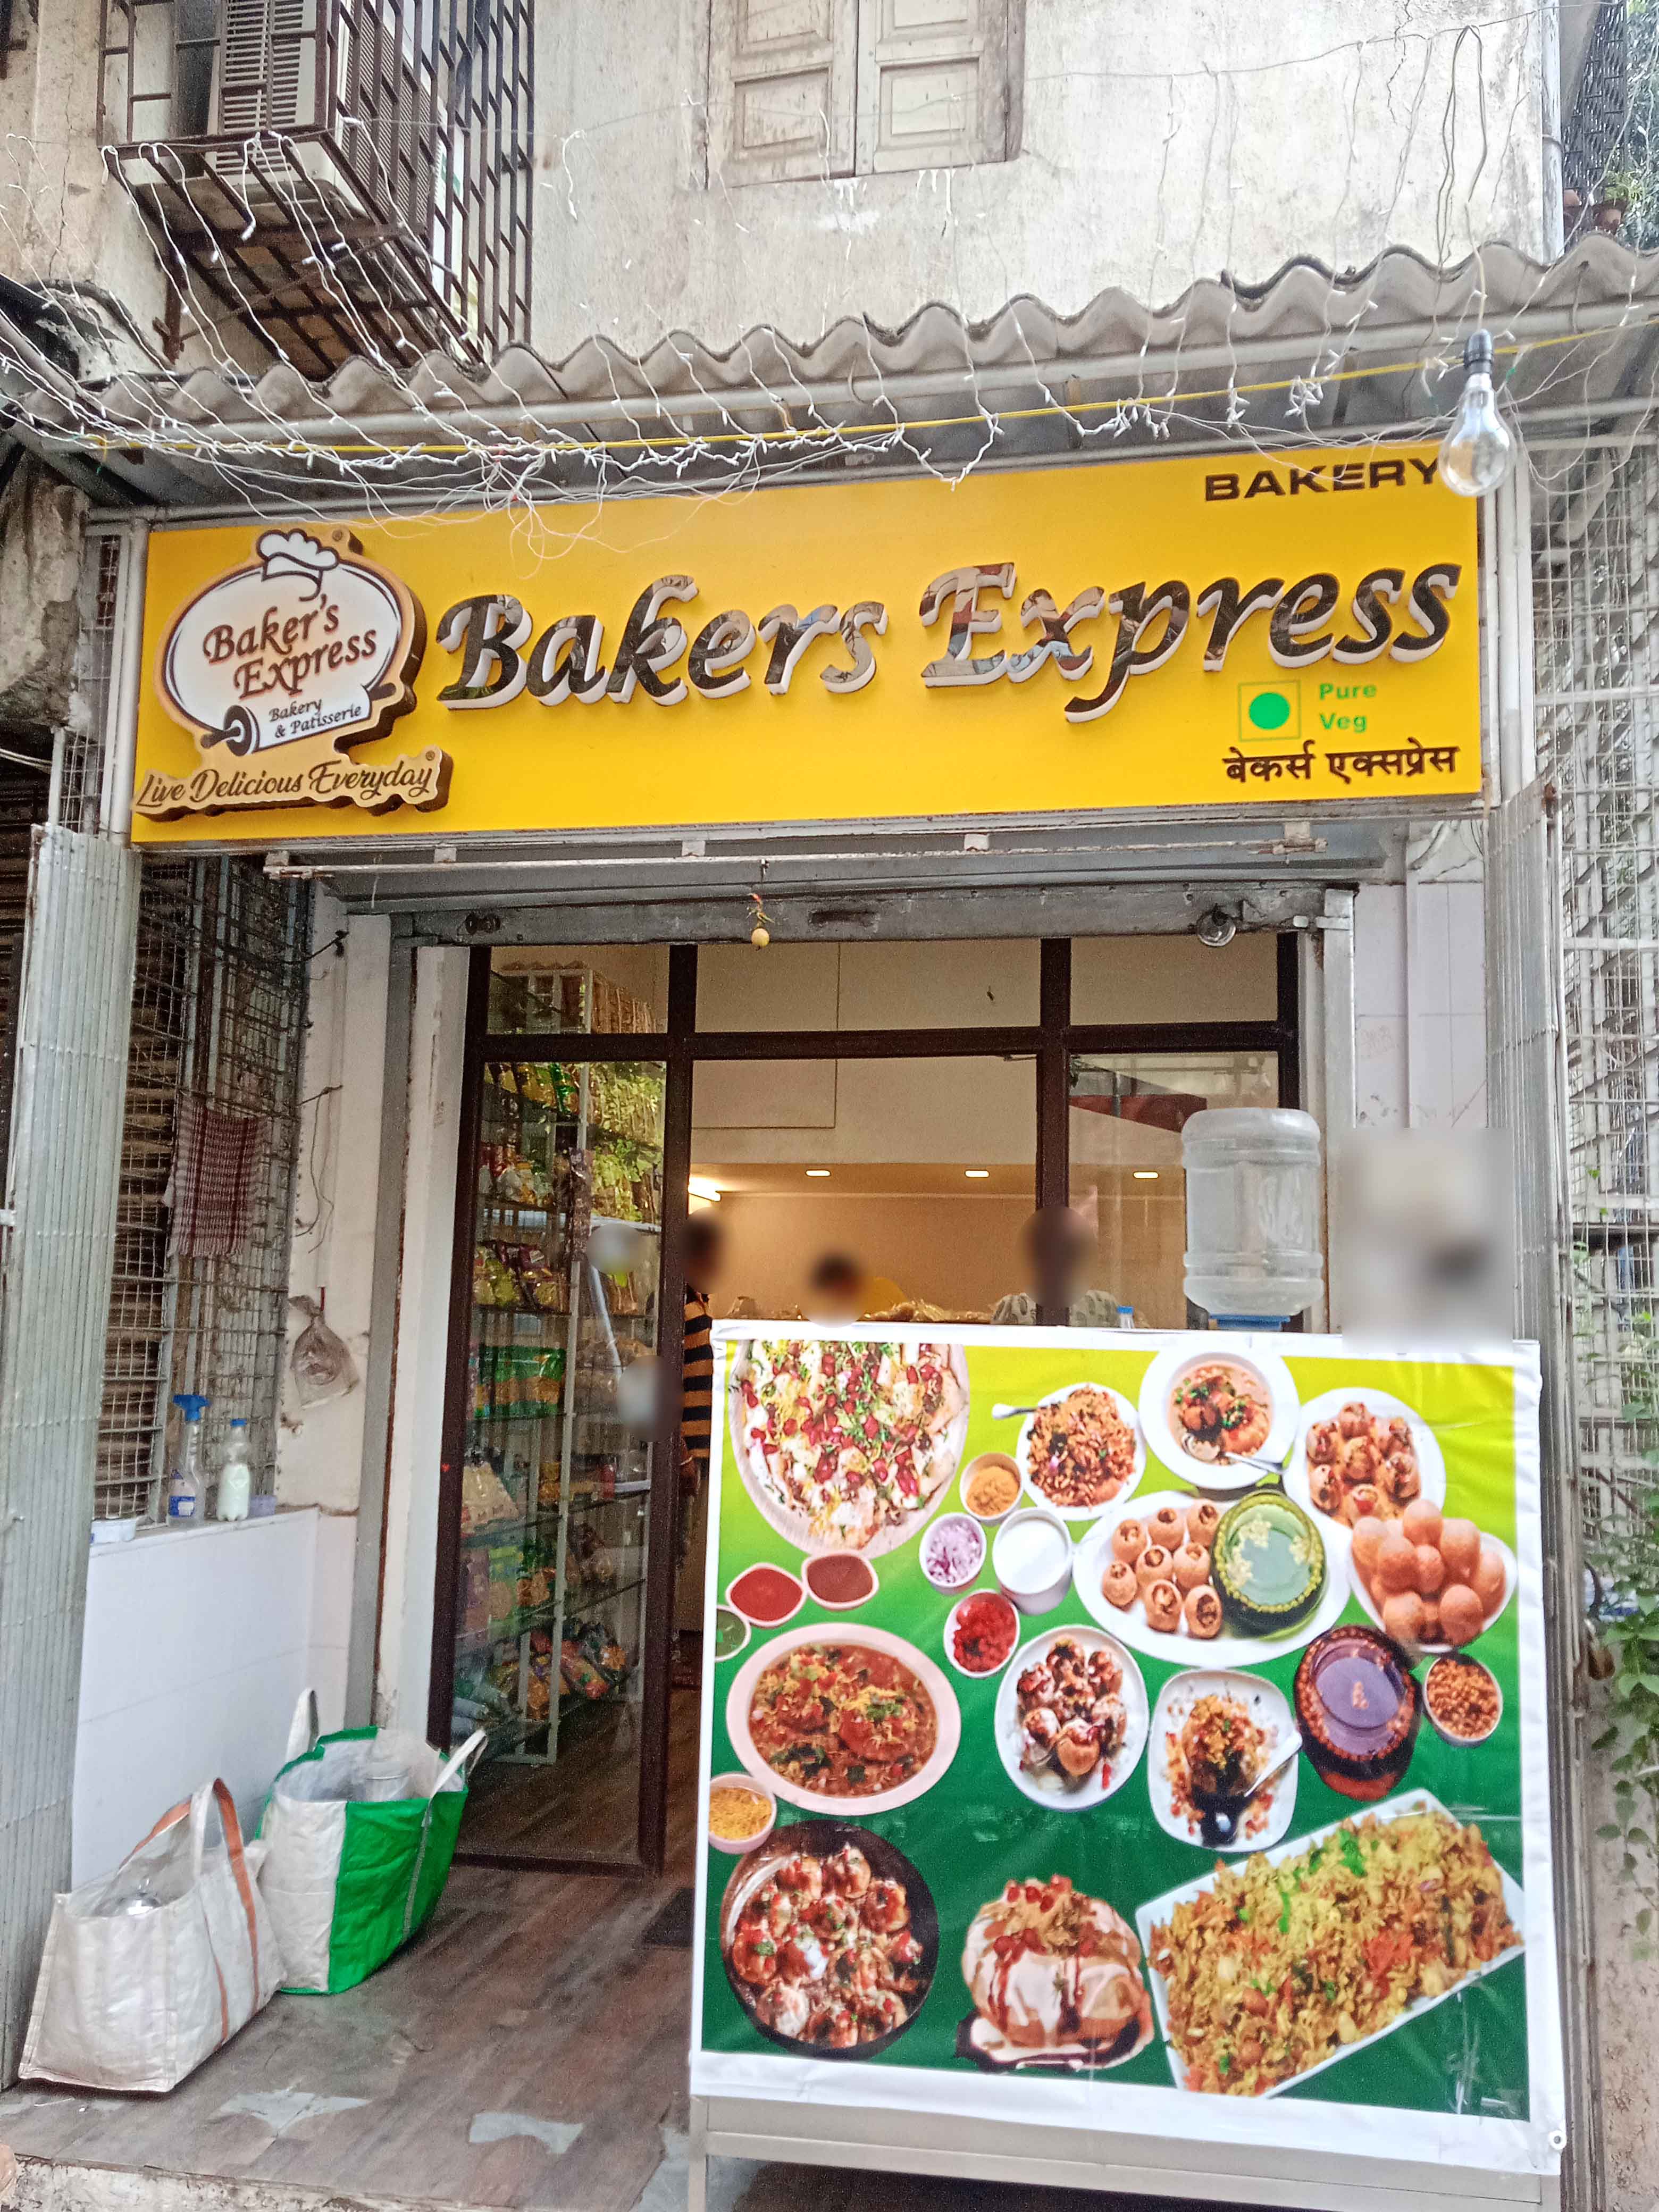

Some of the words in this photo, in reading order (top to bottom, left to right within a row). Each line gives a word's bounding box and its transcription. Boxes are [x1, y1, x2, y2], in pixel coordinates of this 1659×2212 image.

[1205, 456, 1439, 501] BAKERY
[202, 593, 340, 665] Baker's
[435, 574, 889, 711] Bakers
[919, 562, 1463, 723] Express
[232, 629, 377, 699] Express
[269, 698, 323, 722] Bakery
[1319, 682, 1377, 700] Pure
[274, 725, 286, 739] &
[290, 704, 363, 735] Patisserie
[1319, 713, 1368, 733] Veg
[136, 773, 186, 808] Live
[190, 769, 303, 803] Delicious
[308, 759, 433, 801] Everyday
[1222, 739, 1316, 783] बेकर्स
[1326, 737, 1461, 784] एक्सप्रेस
